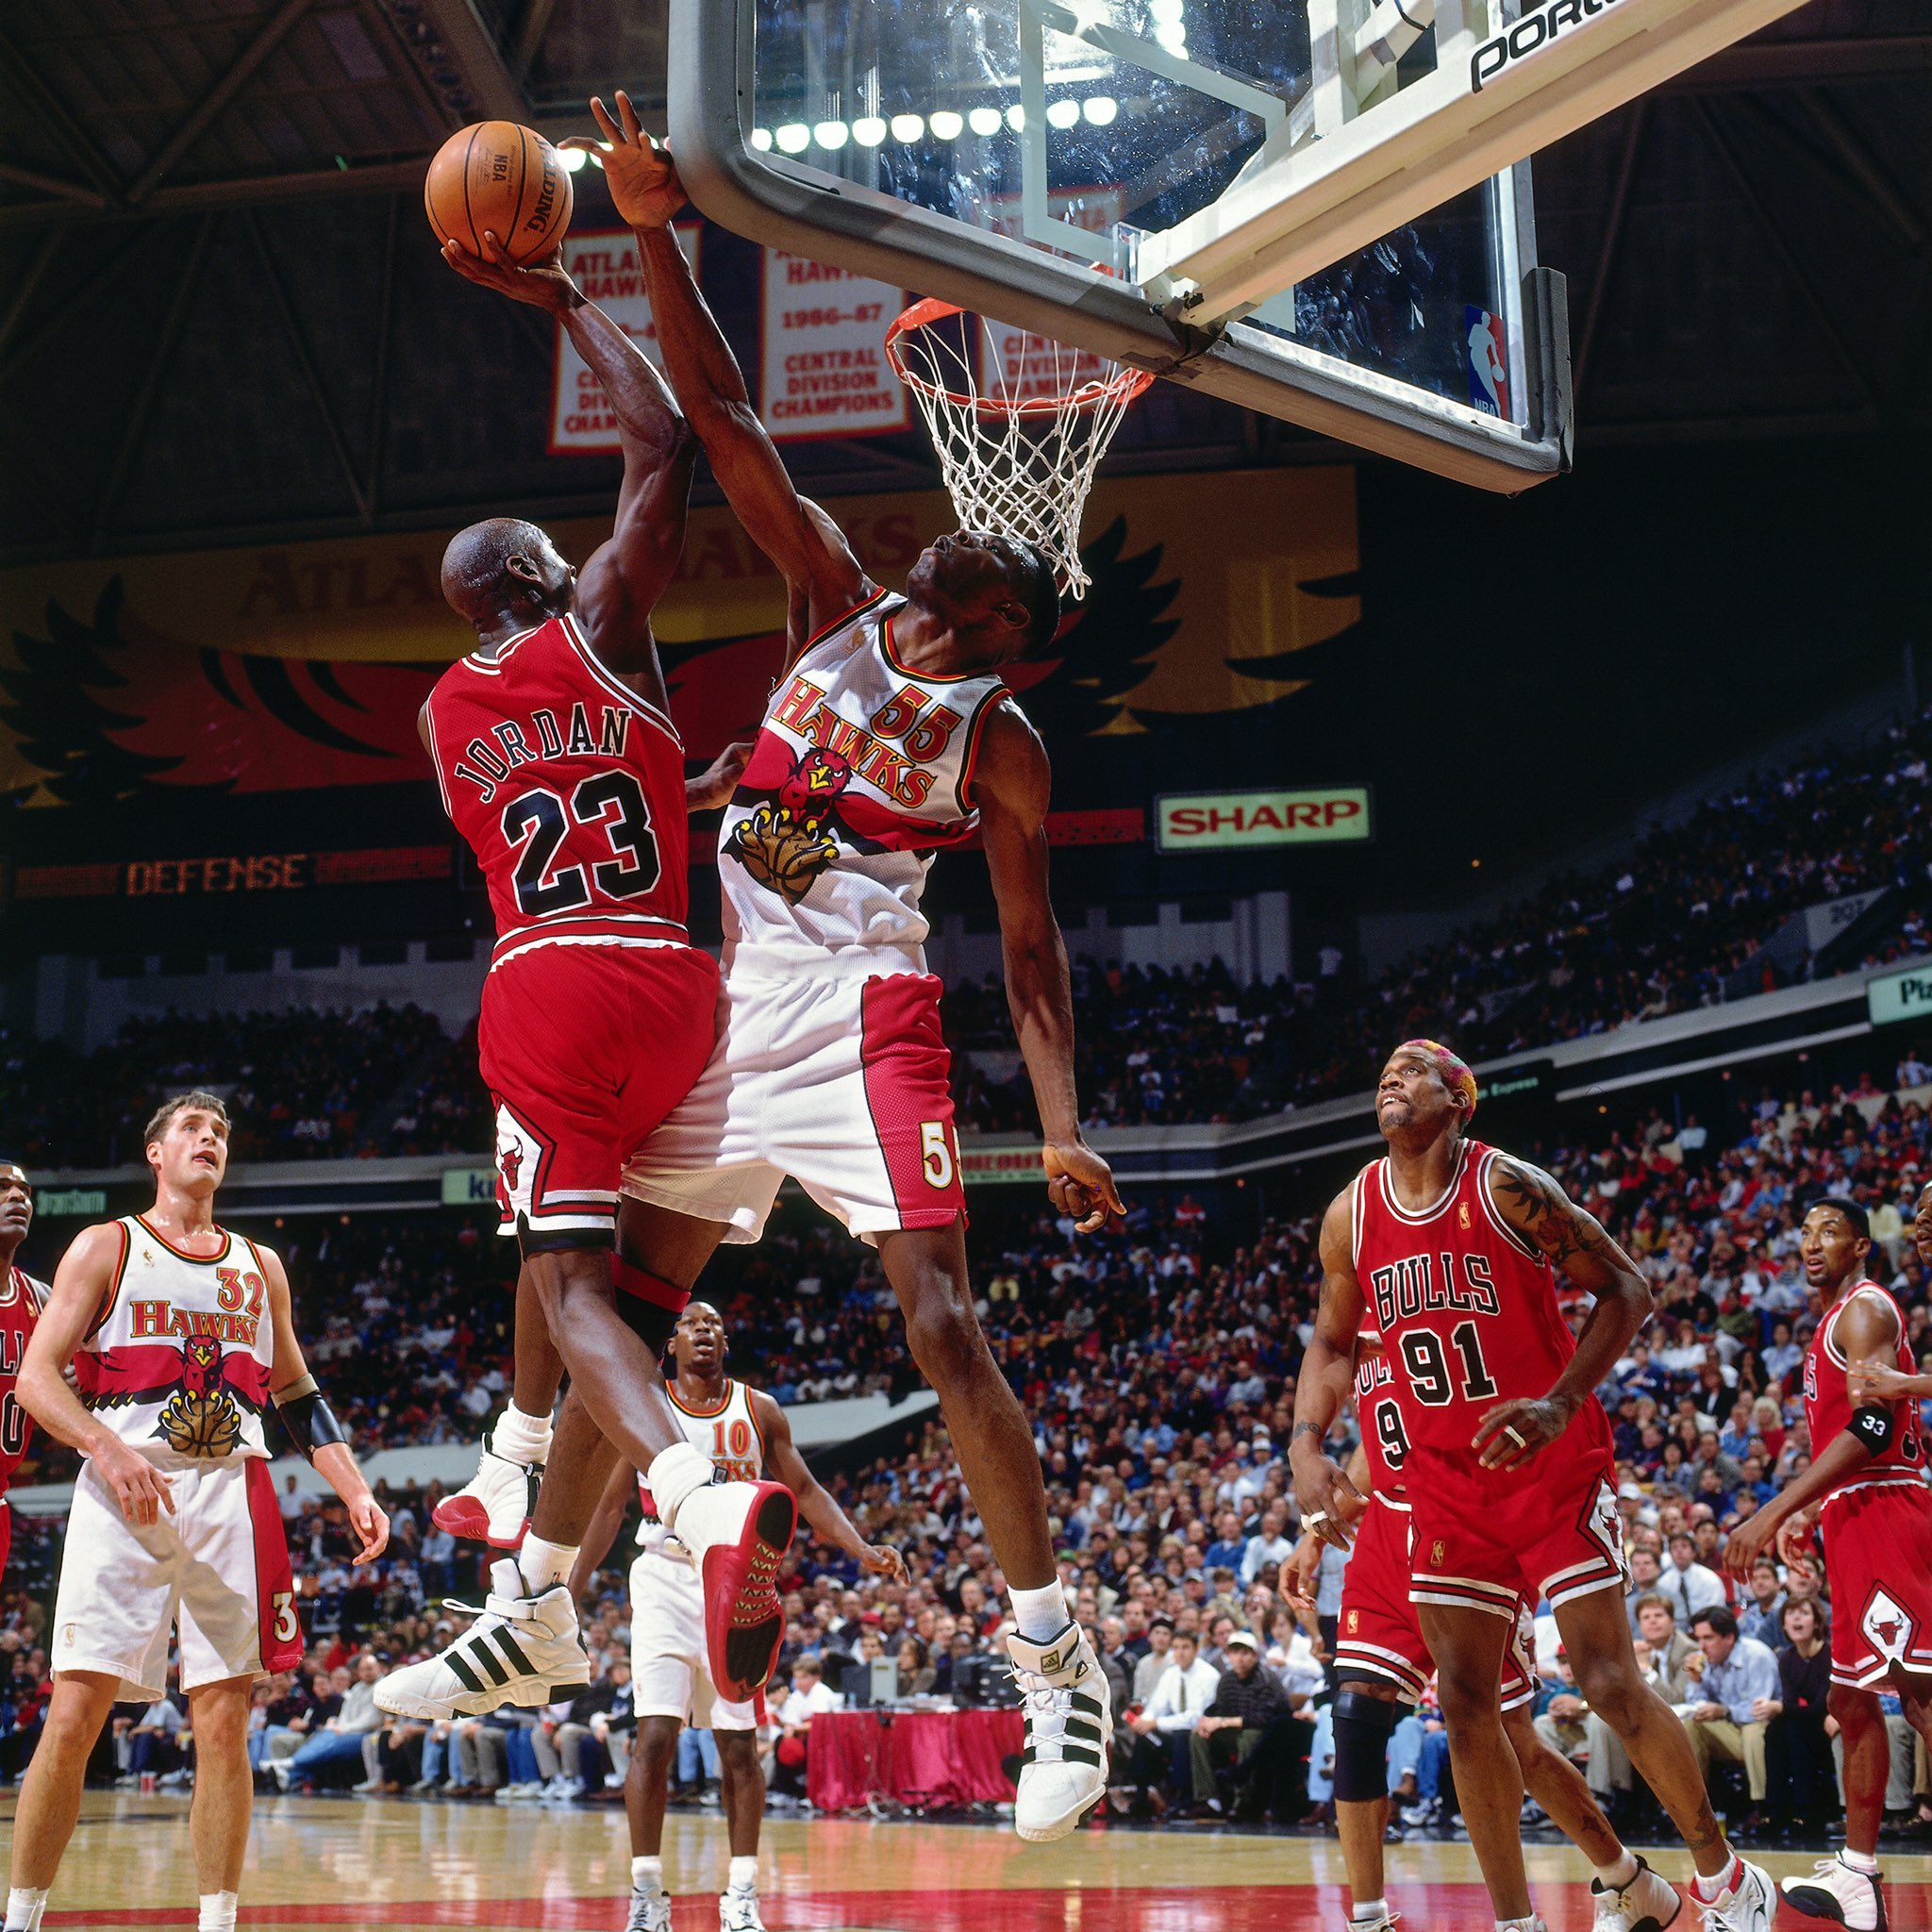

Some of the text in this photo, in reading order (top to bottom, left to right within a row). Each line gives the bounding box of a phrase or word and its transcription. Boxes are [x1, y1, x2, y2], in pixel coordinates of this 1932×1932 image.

[492, 154, 508, 182] NBA
[526, 136, 557, 234] LDING
[571, 249, 636, 275] ATLA
[787, 260, 862, 285] HAW
[581, 277, 648, 299] HAW
[784, 347, 881, 375] CENTRAL
[787, 371, 878, 396] DIVISION
[771, 391, 894, 420] CHAMPIONS
[1474, 397, 1497, 415] NBA
[234, 553, 439, 619] ATLA
[771, 675, 938, 809] HAWKS
[870, 683, 964, 763] 55
[454, 701, 633, 805] JORDAN
[1168, 799, 1362, 837] SHARP
[500, 768, 662, 919] 23
[125, 853, 308, 897] DEFENSE
[920, 1120, 964, 1192] 5
[216, 1266, 265, 1321] 32
[1371, 1252, 1502, 1333] BULLS
[129, 1299, 259, 1351] HAWKS
[1398, 1320, 1499, 1407] 91
[712, 1418, 752, 1457] 10
[1861, 1415, 1886, 1437] 33
[272, 1591, 298, 1644] 3
